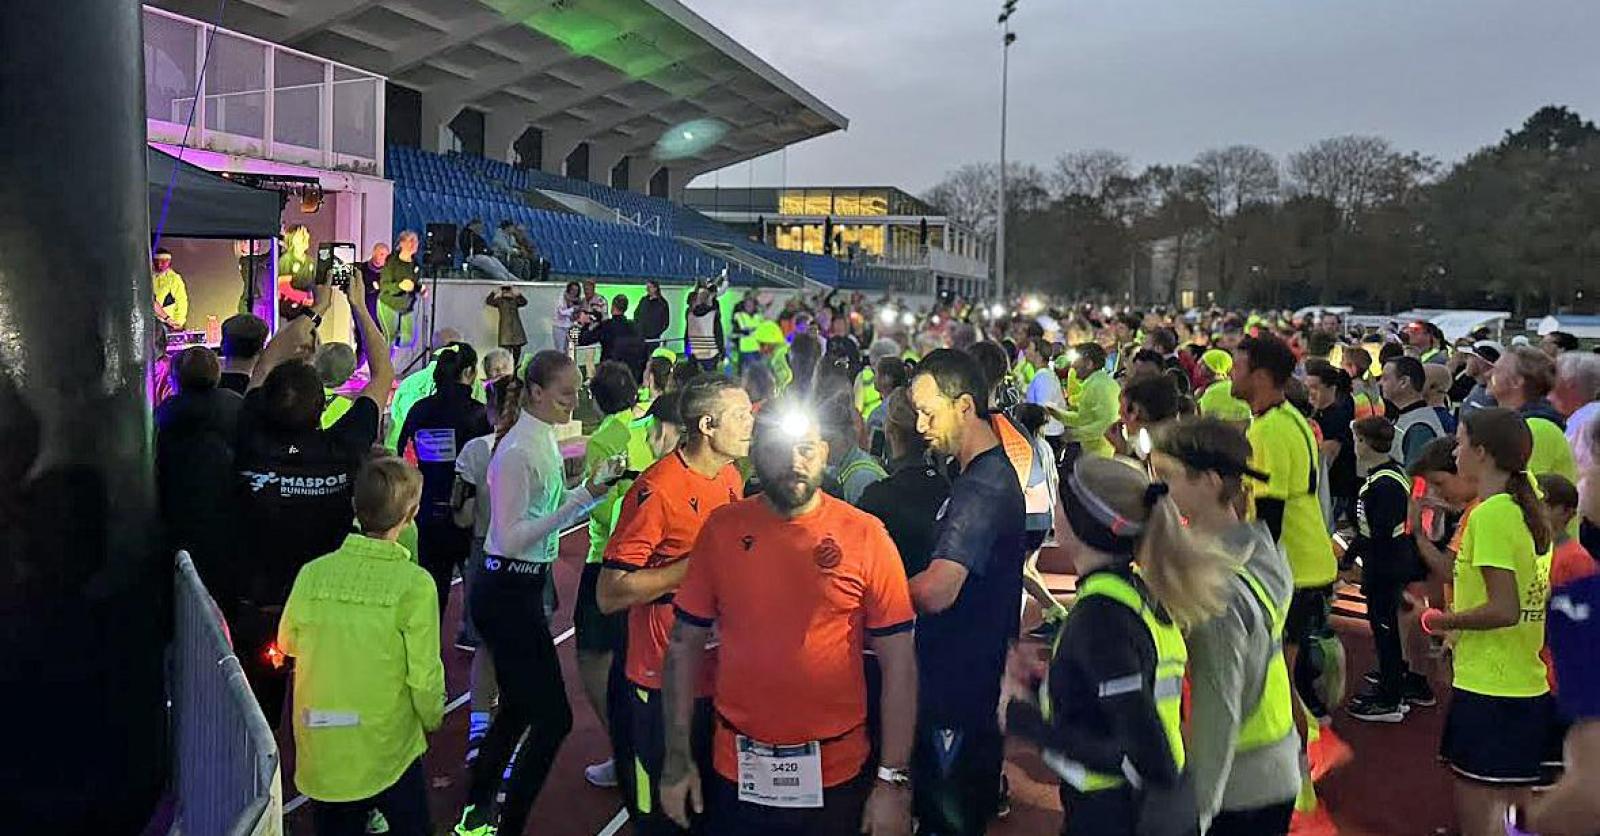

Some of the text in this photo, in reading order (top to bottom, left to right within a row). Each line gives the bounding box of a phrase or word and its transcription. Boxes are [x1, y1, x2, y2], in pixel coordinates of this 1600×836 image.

[281, 486, 325, 495] RUNNING
[508, 562, 541, 574] NIKE
[771, 762, 798, 772] 3420
